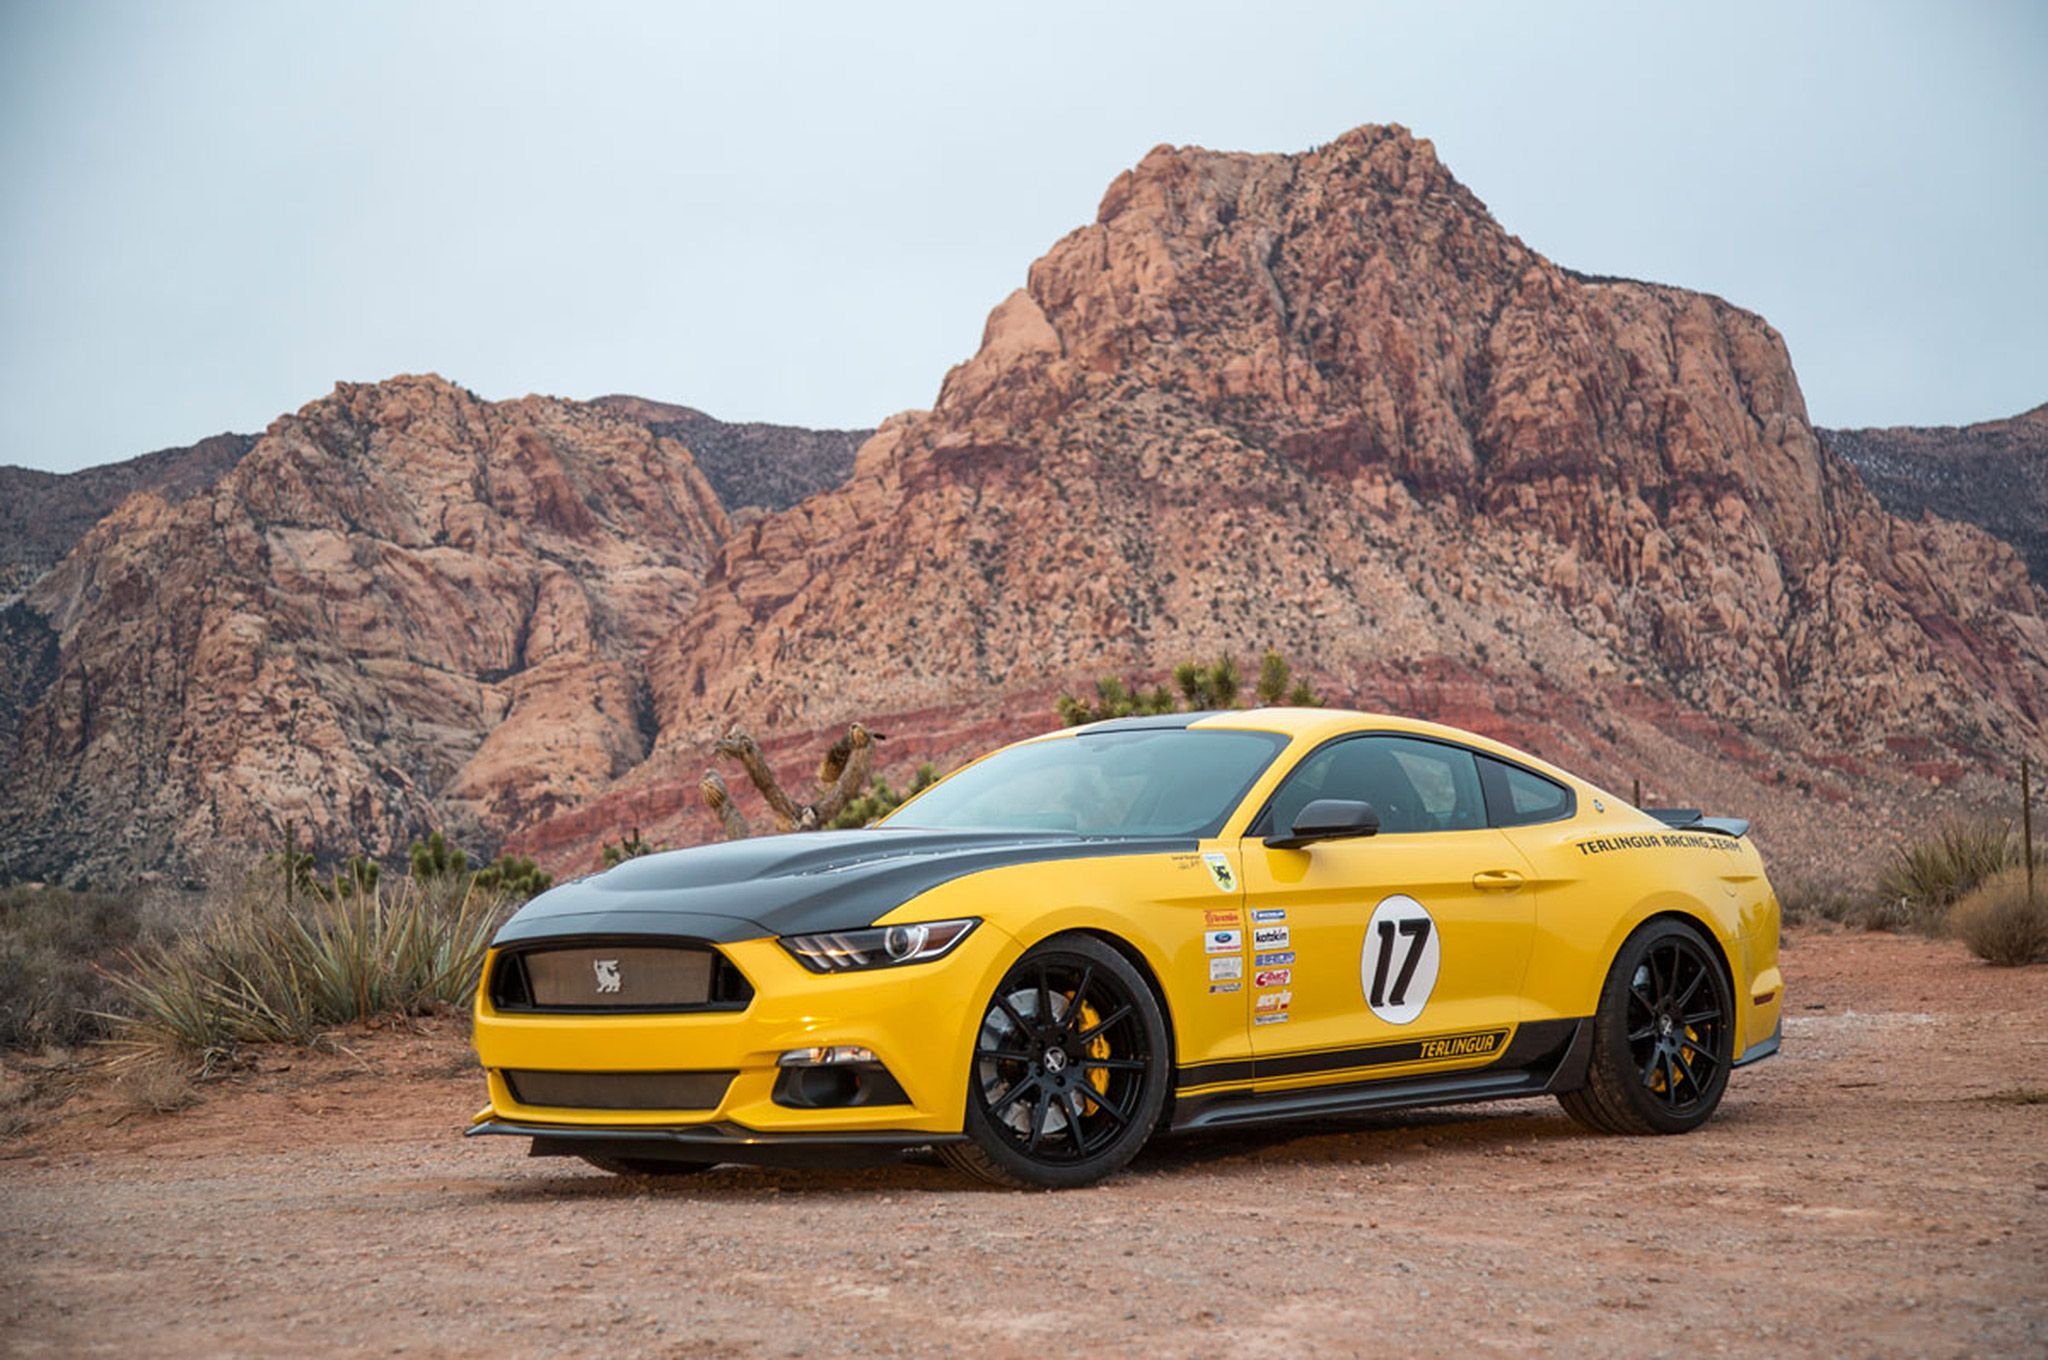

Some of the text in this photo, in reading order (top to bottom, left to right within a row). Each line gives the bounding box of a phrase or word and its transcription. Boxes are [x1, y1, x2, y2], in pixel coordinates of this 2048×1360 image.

[1576, 835, 1661, 855] TERLINGUA
[1664, 835, 1708, 848] RACING
[1370, 918, 1431, 1007] 17
[1420, 1035, 1495, 1058] TERLINGUA
